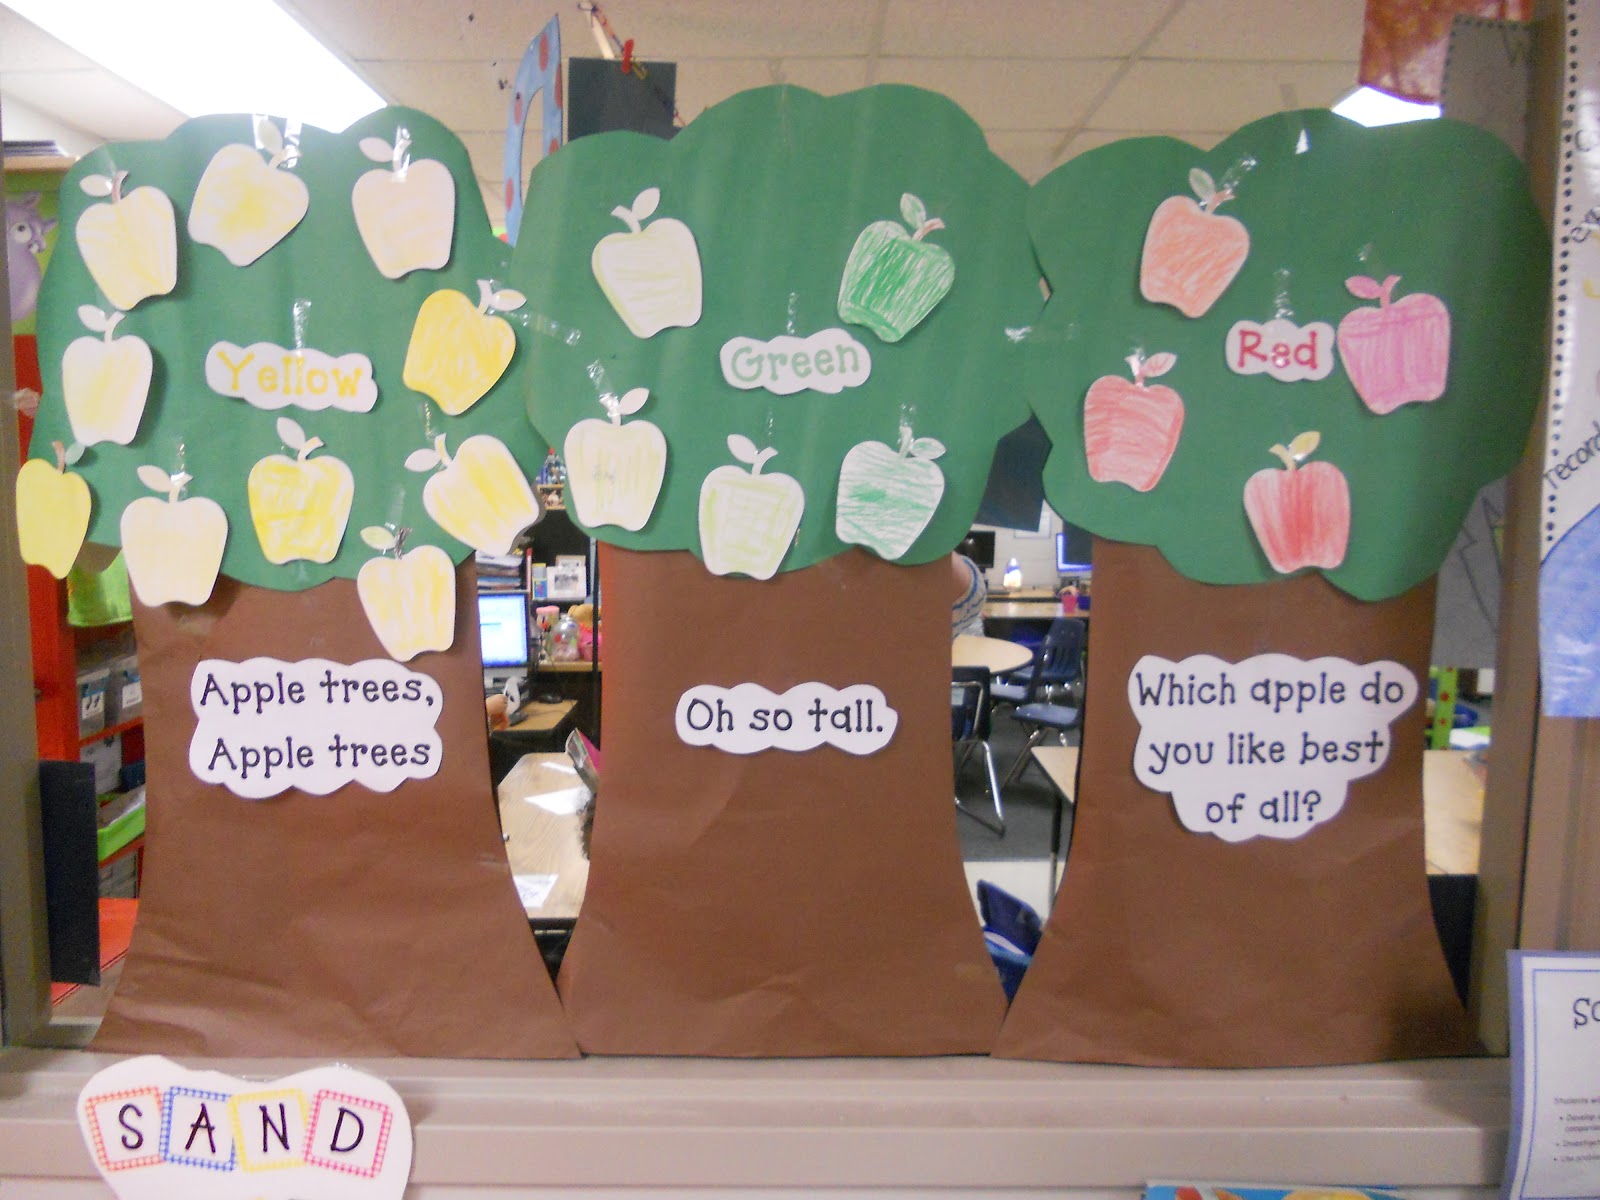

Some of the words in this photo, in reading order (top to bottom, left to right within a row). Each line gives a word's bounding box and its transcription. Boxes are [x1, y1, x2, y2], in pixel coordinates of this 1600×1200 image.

[731, 343, 859, 382] Green
[1238, 330, 1317, 370] Red
[217, 351, 363, 397] Yellow
[200, 672, 305, 714] Apple
[319, 669, 434, 706] trees,
[1135, 672, 1236, 706] Which
[1250, 672, 1346, 713] apple
[1360, 671, 1404, 705] do
[686, 698, 734, 733] Oh
[749, 708, 793, 732] so
[808, 698, 883, 733] tall.
[208, 736, 314, 779] Apple
[328, 734, 431, 767] trees
[1148, 742, 1215, 774] you
[1227, 731, 1285, 764] like
[1299, 730, 1384, 765] best
[1205, 793, 1246, 824] of
[1259, 789, 1321, 823] all?
